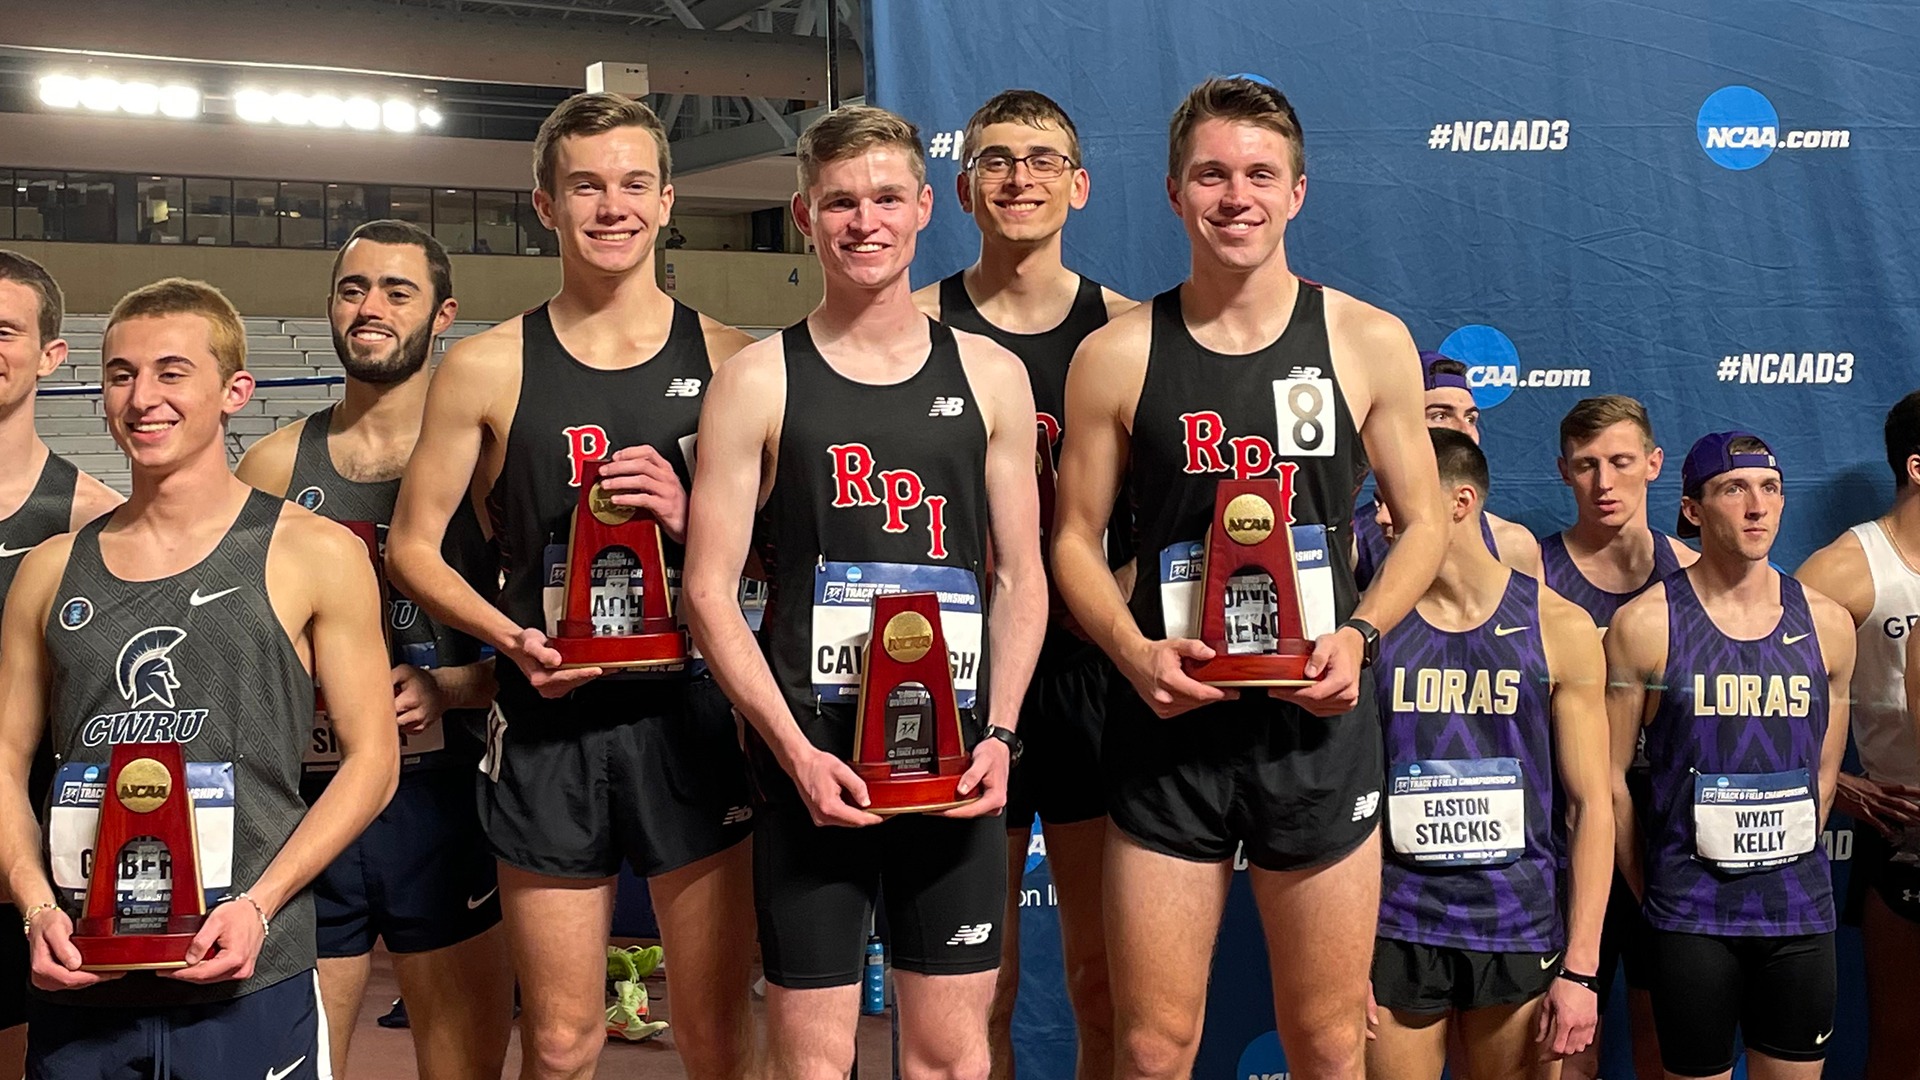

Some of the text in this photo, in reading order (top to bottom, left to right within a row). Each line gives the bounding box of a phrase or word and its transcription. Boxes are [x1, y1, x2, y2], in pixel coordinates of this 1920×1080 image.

[1428, 119, 1570, 152] #NCAAD3
[1706, 127, 1850, 149] NCAA.com
[788, 268, 800, 286] 4
[1466, 366, 1591, 388] CAA.com
[1717, 352, 1855, 385] #NCAAD3
[1288, 383, 1325, 451] 8
[1179, 410, 1300, 525] RPI
[827, 442, 949, 559] RPI
[1228, 517, 1271, 533] NCAA
[1393, 667, 1521, 715] LORAS
[1694, 674, 1811, 717] LORAS
[82, 709, 209, 747] CWRU
[1410, 780, 1431, 788] TRACK
[1717, 791, 1739, 800] TRACK
[1424, 797, 1490, 818] EASTON
[1735, 809, 1784, 828] WYATT
[1416, 820, 1502, 845] STACKIS
[1734, 830, 1787, 853] KELLY
